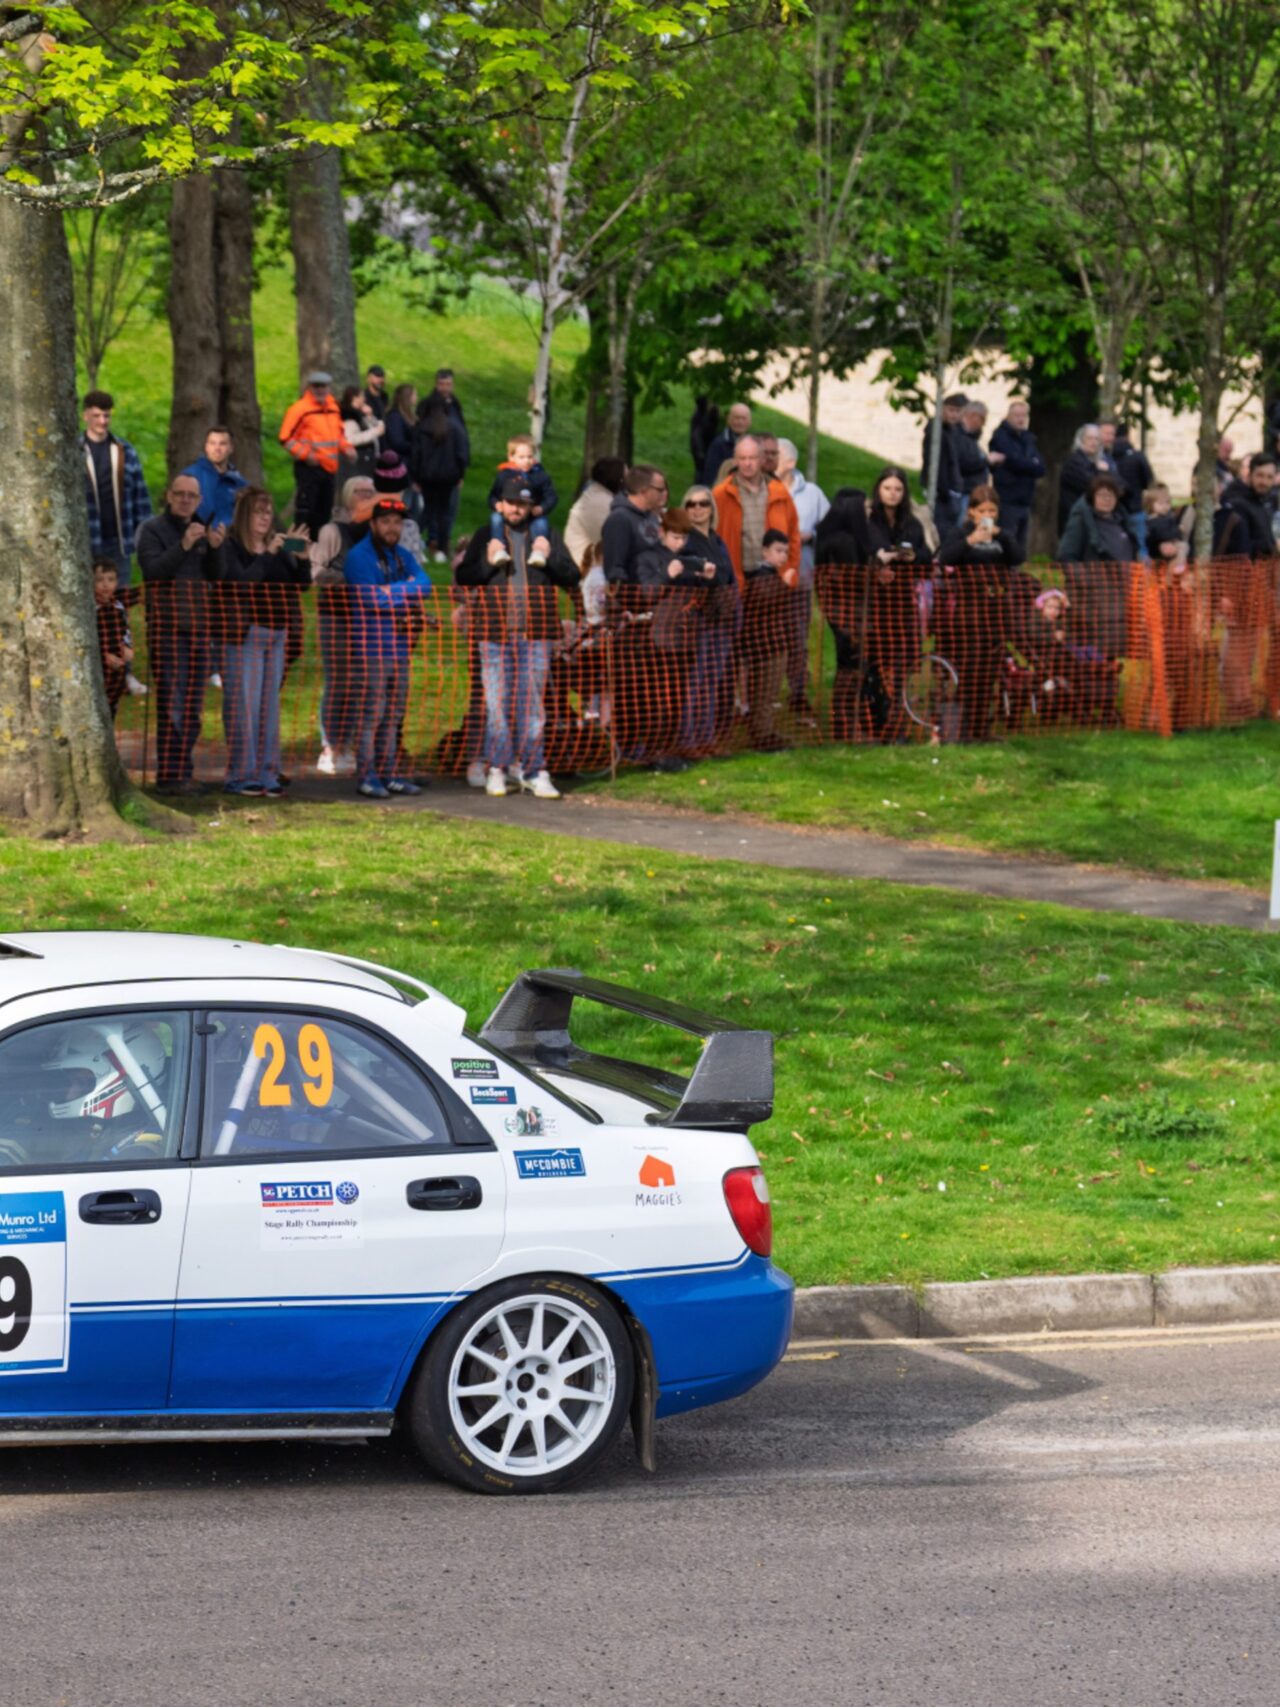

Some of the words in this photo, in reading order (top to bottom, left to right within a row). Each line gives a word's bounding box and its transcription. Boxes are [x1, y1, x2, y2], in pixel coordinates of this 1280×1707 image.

[254, 1023, 334, 1107] 29
[453, 1060, 491, 1070] positive
[276, 1184, 330, 1199] PETCH
[635, 1192, 683, 1207] MAGGIE'S
[38, 1210, 57, 1224] Ltd
[264, 1220, 284, 1229] Stage
[286, 1219, 304, 1228] Rally
[306, 1218, 357, 1228] Championship
[545, 1279, 600, 1309] ZERO
